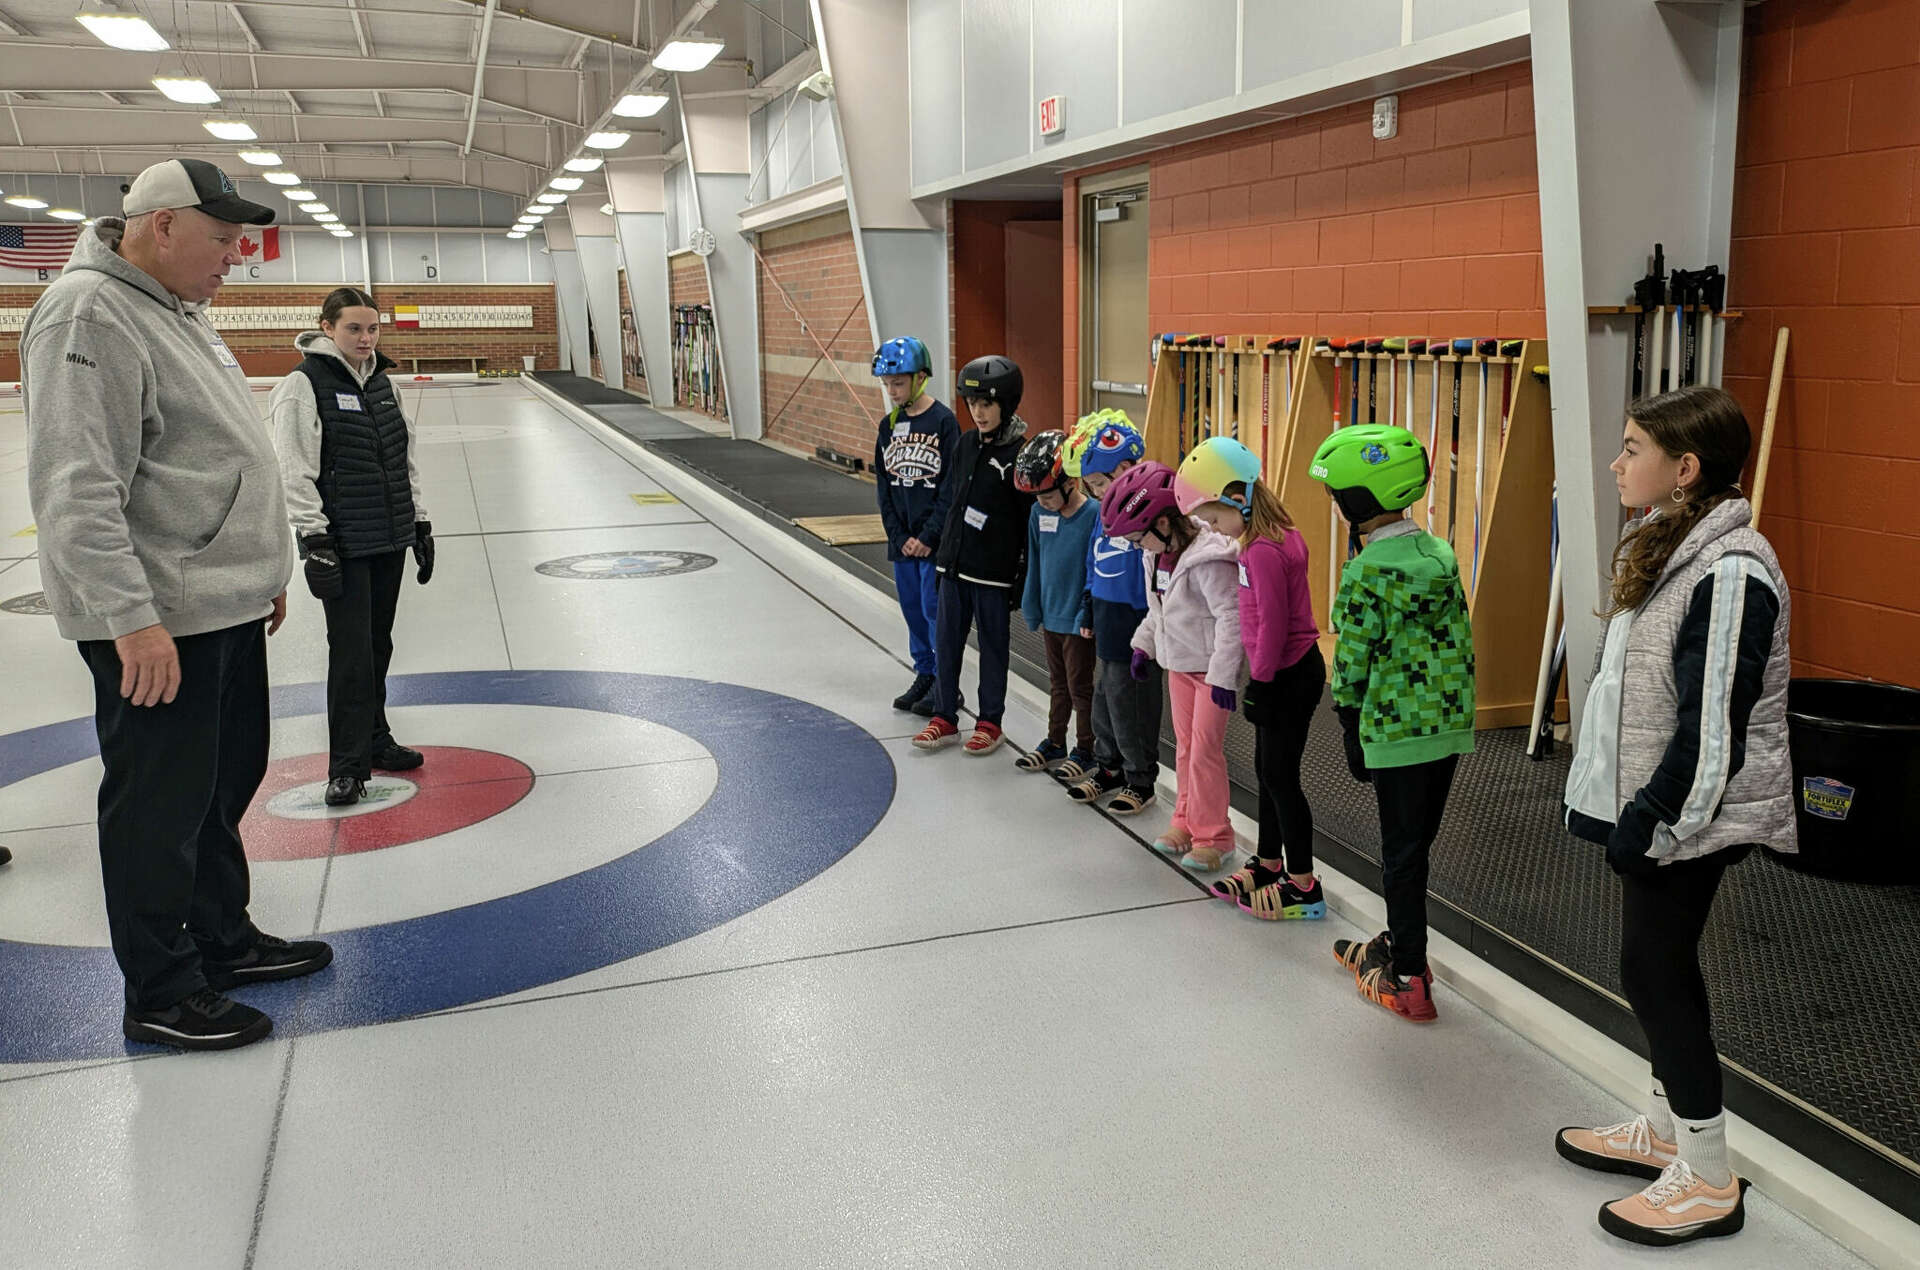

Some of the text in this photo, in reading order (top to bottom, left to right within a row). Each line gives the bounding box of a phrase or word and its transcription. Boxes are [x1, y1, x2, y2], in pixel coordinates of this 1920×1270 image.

[1041, 98, 1056, 131] EXIT
[38, 269, 48, 280] B
[250, 266, 260, 278] C
[427, 266, 437, 278] D
[65, 352, 97, 369] Mike
[899, 466, 922, 477] CLUB
[1312, 465, 1329, 479] GIRO
